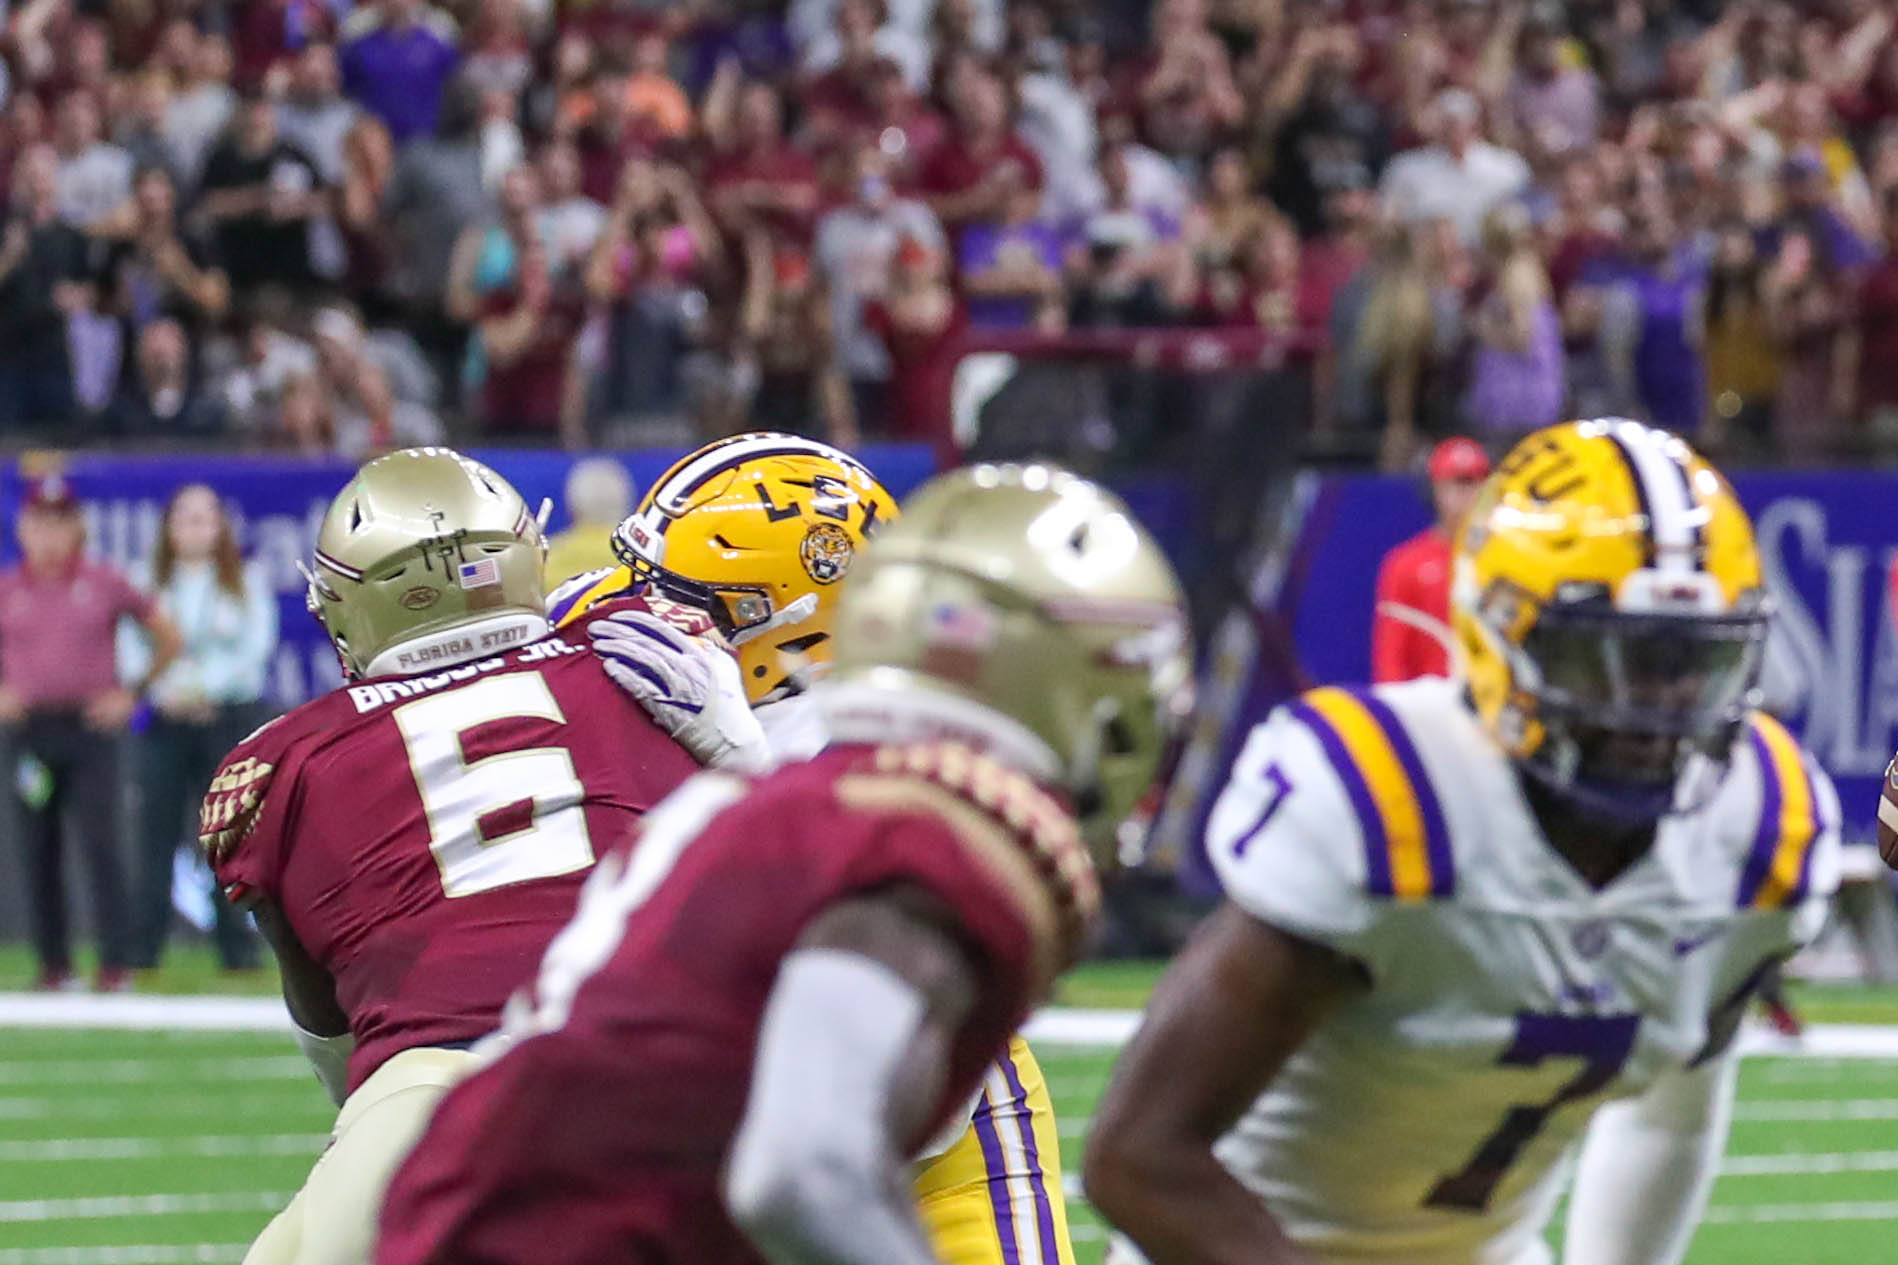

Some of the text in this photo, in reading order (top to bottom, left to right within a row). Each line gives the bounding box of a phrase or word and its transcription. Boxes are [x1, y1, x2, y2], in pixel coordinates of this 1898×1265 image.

[397, 624, 528, 670] FLORIDA STATE
[391, 669, 598, 899] 6
[1230, 760, 1295, 858] 7
[1418, 1009, 1641, 1213] 7
